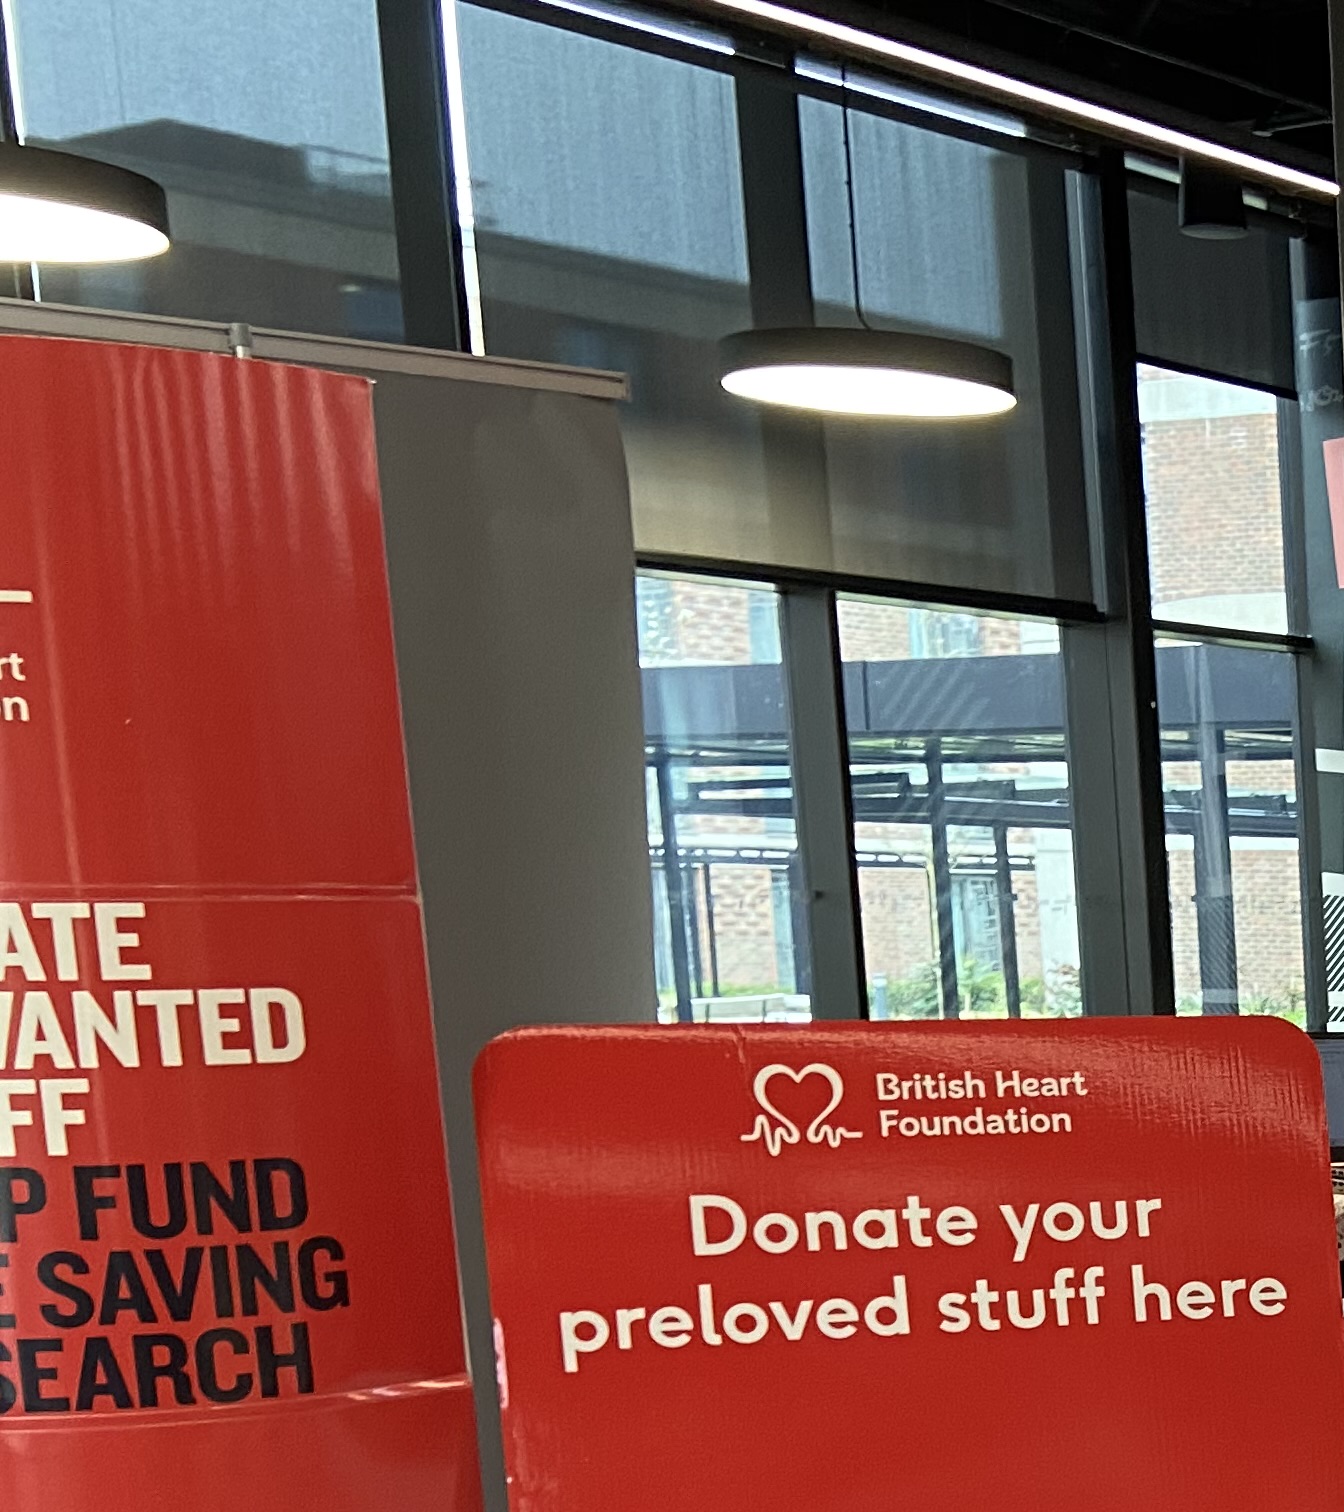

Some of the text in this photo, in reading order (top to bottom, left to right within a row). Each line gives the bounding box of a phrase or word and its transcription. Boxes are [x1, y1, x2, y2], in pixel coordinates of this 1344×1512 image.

[0, 988, 307, 1069] ANTED
[876, 1070, 1088, 1101] British Heart
[879, 1107, 1073, 1138] Foundation
[74, 1157, 309, 1241] FUND
[689, 1194, 1162, 1264] Donate your
[37, 1235, 351, 1330] SAVING
[560, 1264, 1289, 1373] preloved stuff here
